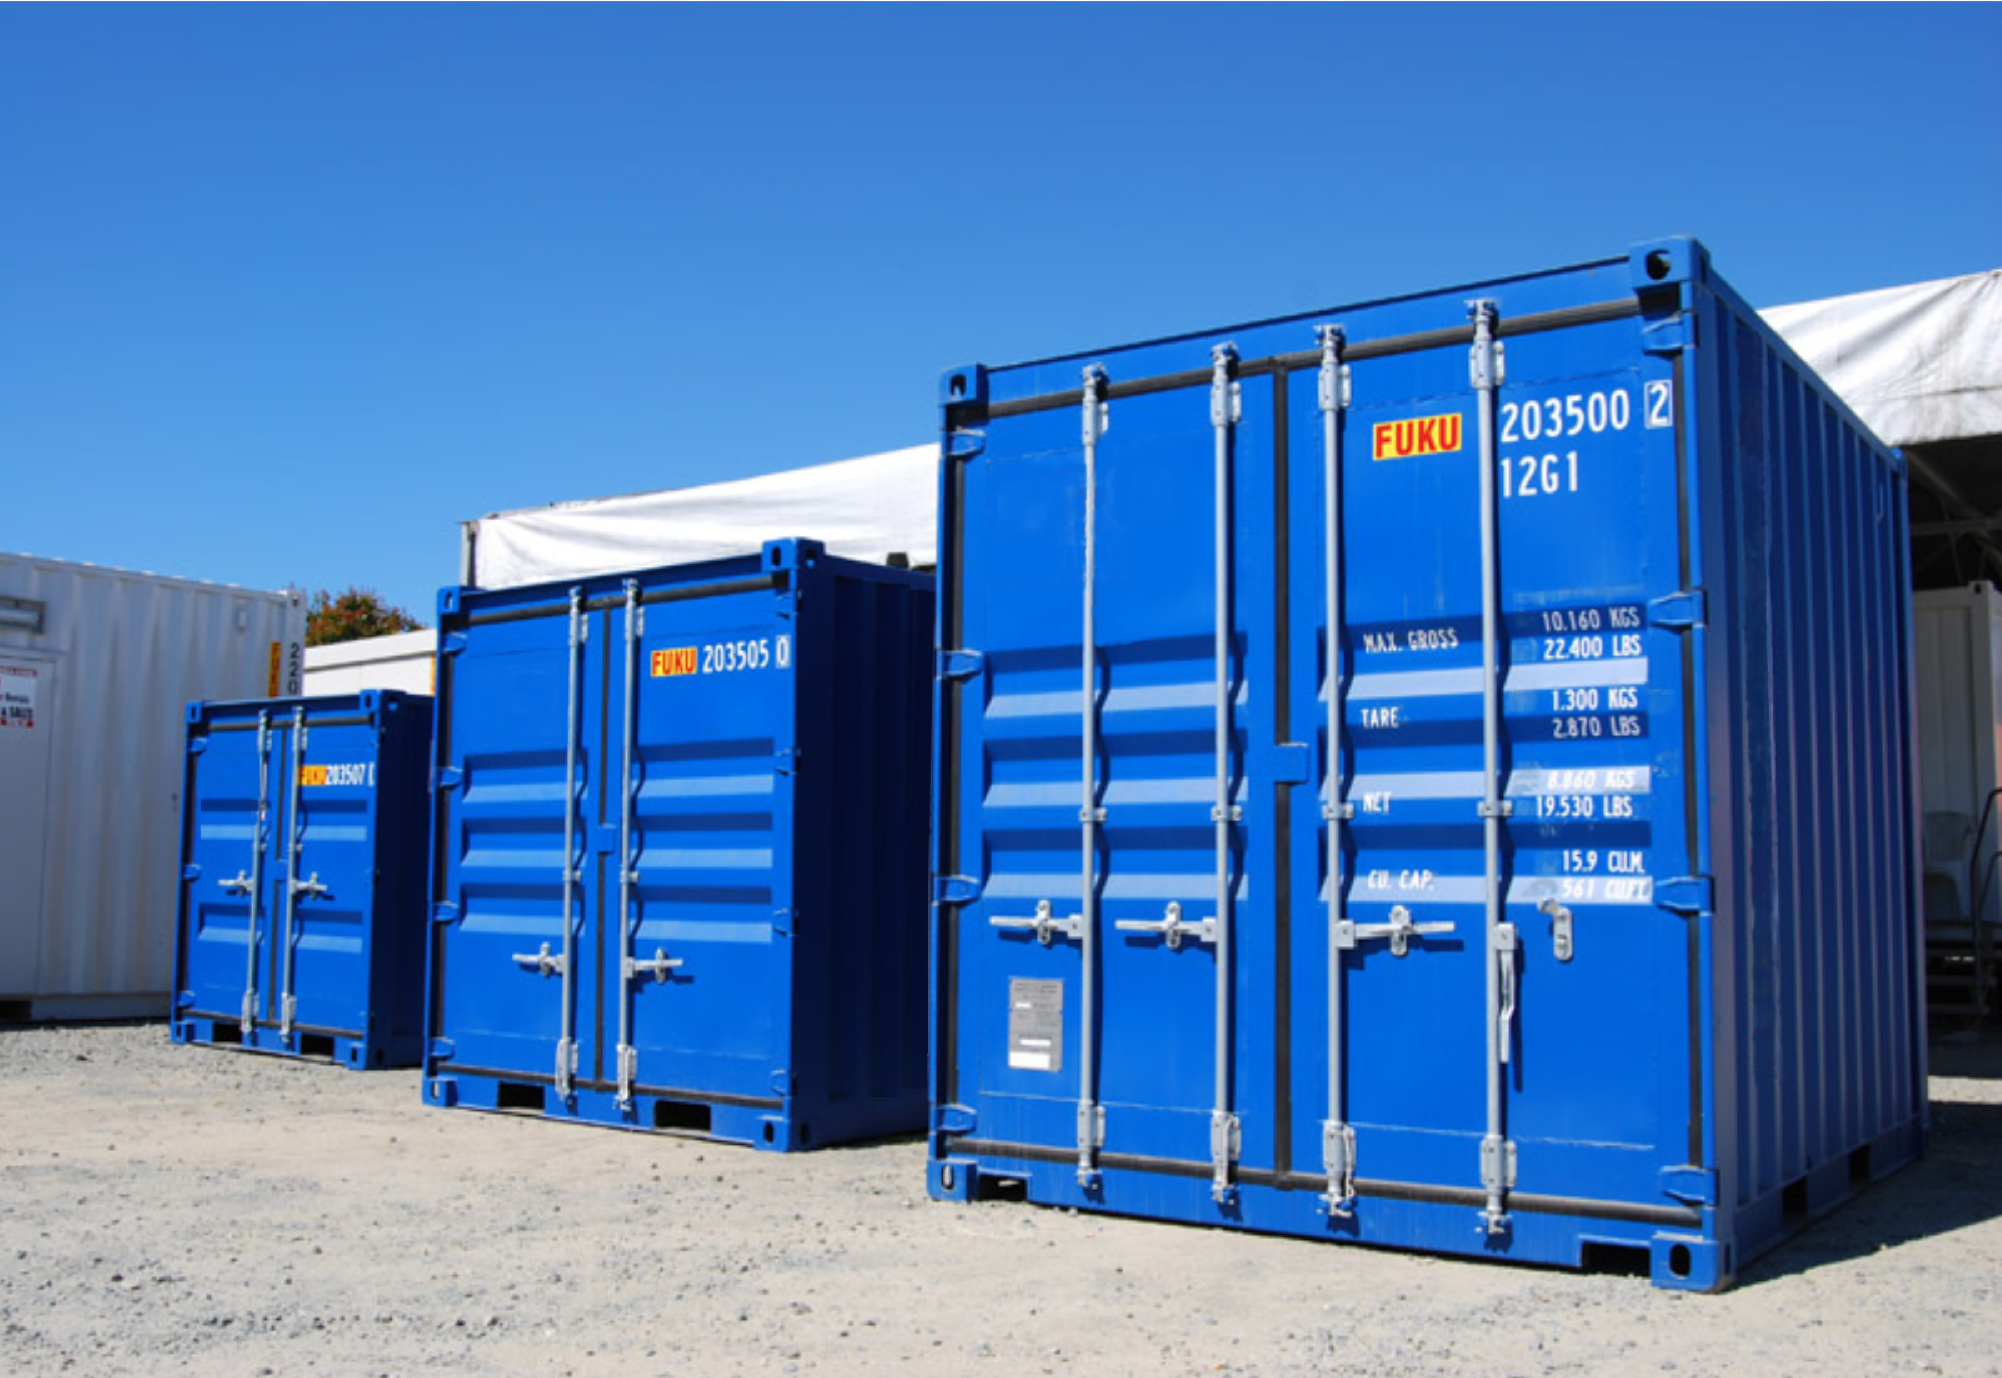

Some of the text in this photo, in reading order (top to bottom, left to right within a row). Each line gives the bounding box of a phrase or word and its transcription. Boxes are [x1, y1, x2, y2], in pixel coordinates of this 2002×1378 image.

[1375, 383, 1670, 459] FUKU 203500 2
[1501, 451, 1578, 497] 12G1
[1363, 606, 1640, 654] MAX. GROSS 10.160 KGS
[1543, 634, 1642, 660] 22.400 LBS
[651, 647, 697, 677] FUKU
[702, 639, 770, 674] 203505
[1360, 686, 1638, 729] TARE 1.300 KGS
[1552, 715, 1641, 738] 2.870 LBS
[1363, 791, 1391, 815] NET
[1605, 768, 1635, 788] KGS
[1536, 795, 1633, 818] 19.530 LBS
[1563, 848, 1598, 873] 15.9
[1561, 878, 1595, 899] 561
